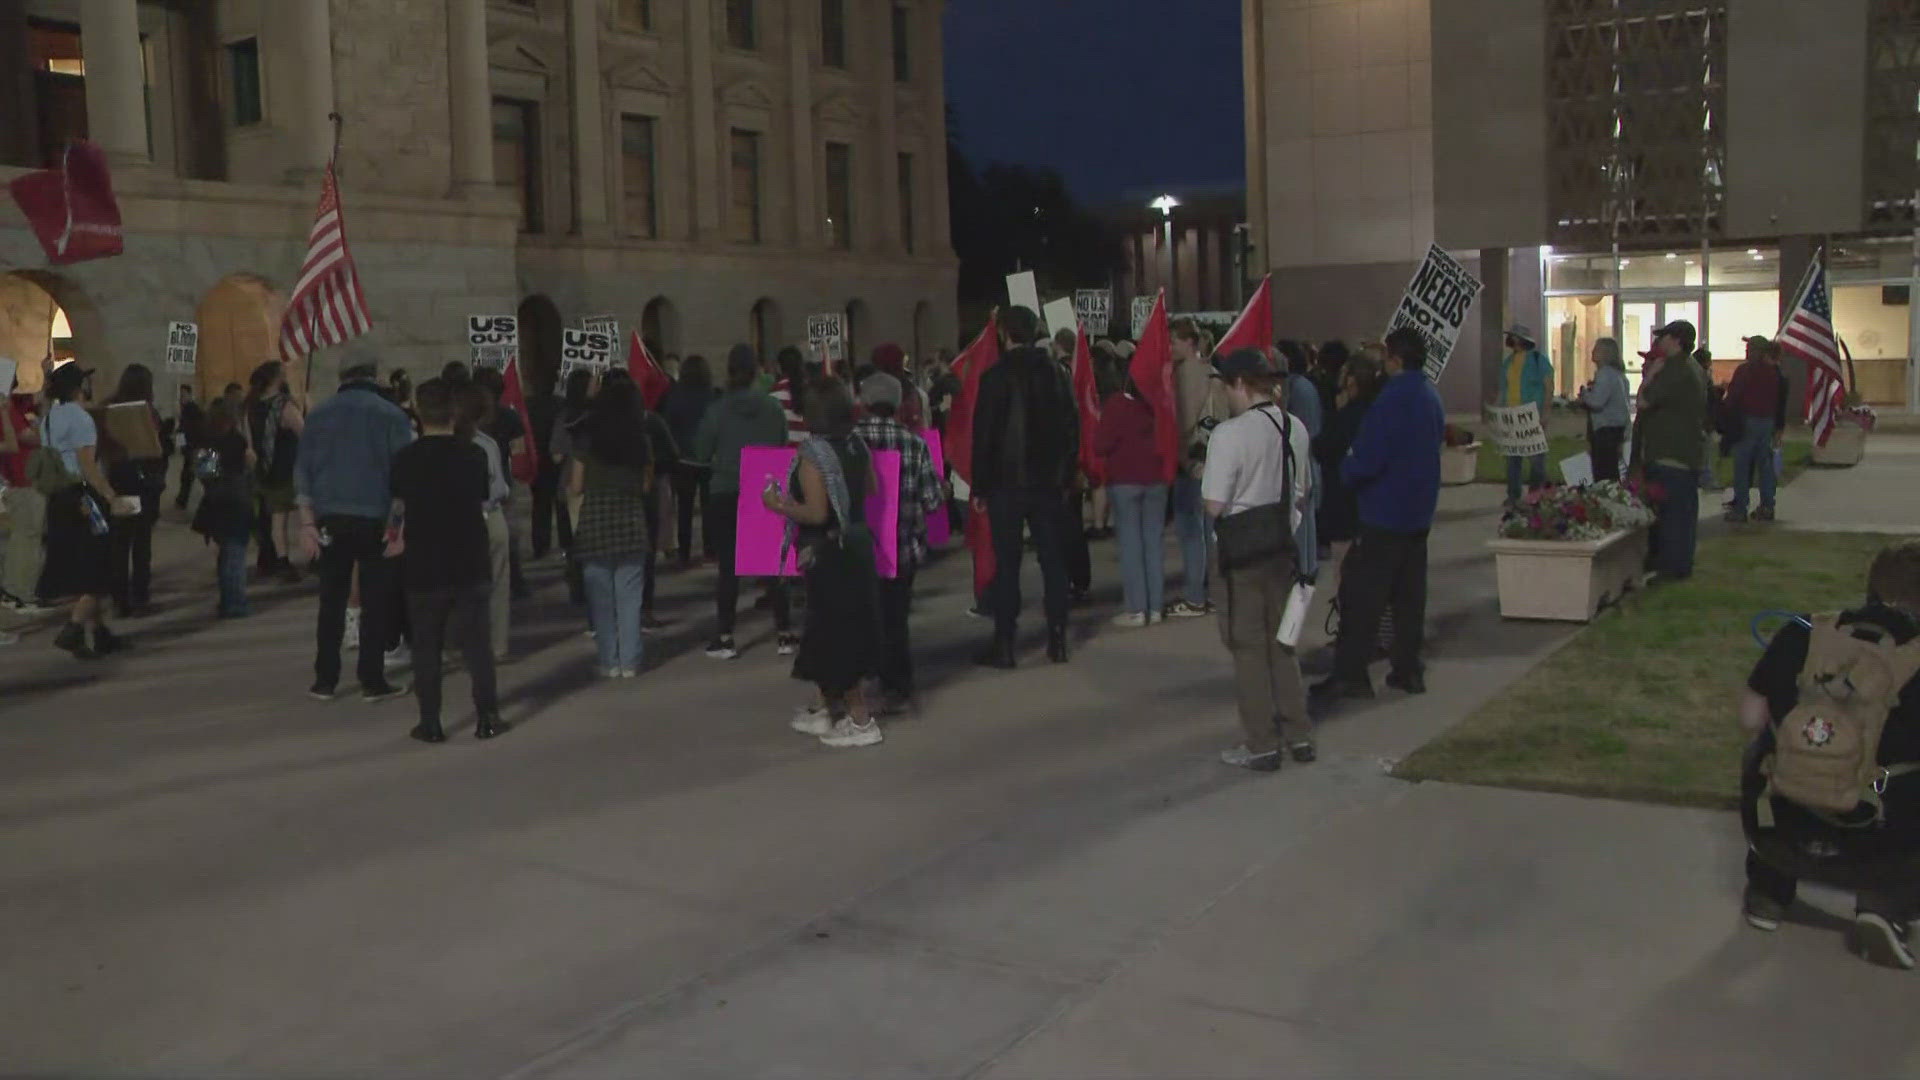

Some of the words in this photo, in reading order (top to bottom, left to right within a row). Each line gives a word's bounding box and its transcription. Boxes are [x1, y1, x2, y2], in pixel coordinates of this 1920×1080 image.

[1410, 259, 1472, 329] NEEDS
[1401, 295, 1444, 335] NOT
[470, 316, 515, 332] US
[810, 320, 839, 338] NEEDS
[470, 333, 516, 344] OUT
[565, 331, 609, 350] US
[564, 348, 608, 362] OUT
[1517, 411, 1533, 424] MY
[1515, 427, 1541, 440] NAME
